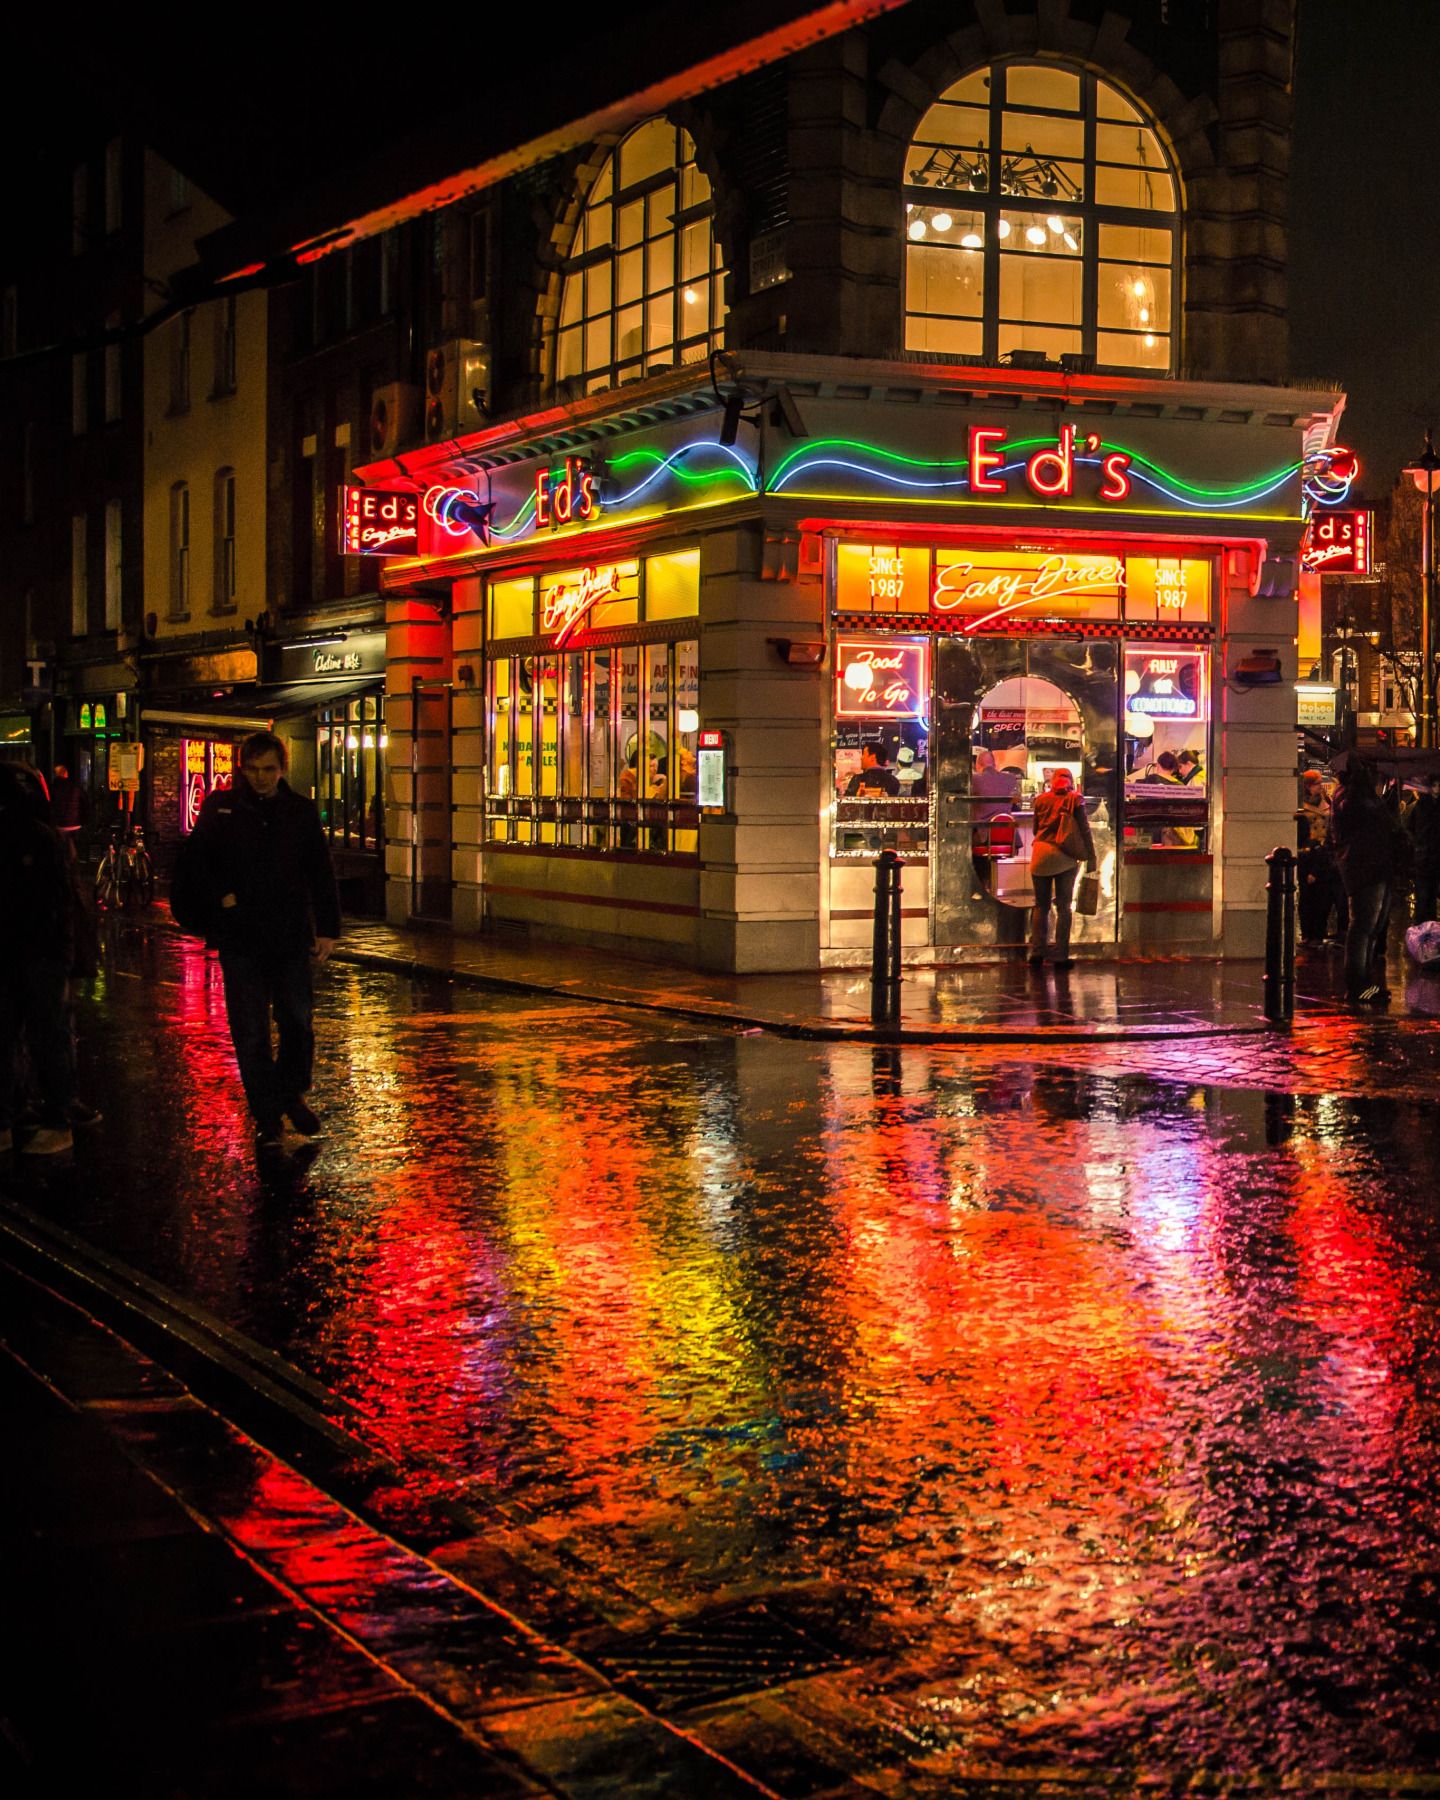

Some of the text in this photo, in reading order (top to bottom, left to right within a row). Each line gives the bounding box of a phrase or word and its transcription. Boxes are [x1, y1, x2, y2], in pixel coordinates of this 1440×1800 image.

[968, 424, 1132, 500] Ed's
[536, 455, 594, 529] Ed's
[363, 497, 416, 520] Ed's
[351, 491, 360, 549] DINER
[869, 556, 904, 575] SINCE
[869, 578, 904, 598] 1987
[933, 554, 1127, 609] Easy Diner
[1155, 568, 1187, 587] SINCE
[1155, 590, 1187, 609] 1987
[856, 650, 905, 669] Food
[884, 681, 910, 709] Go
[993, 722, 1047, 733] SPECIALS
